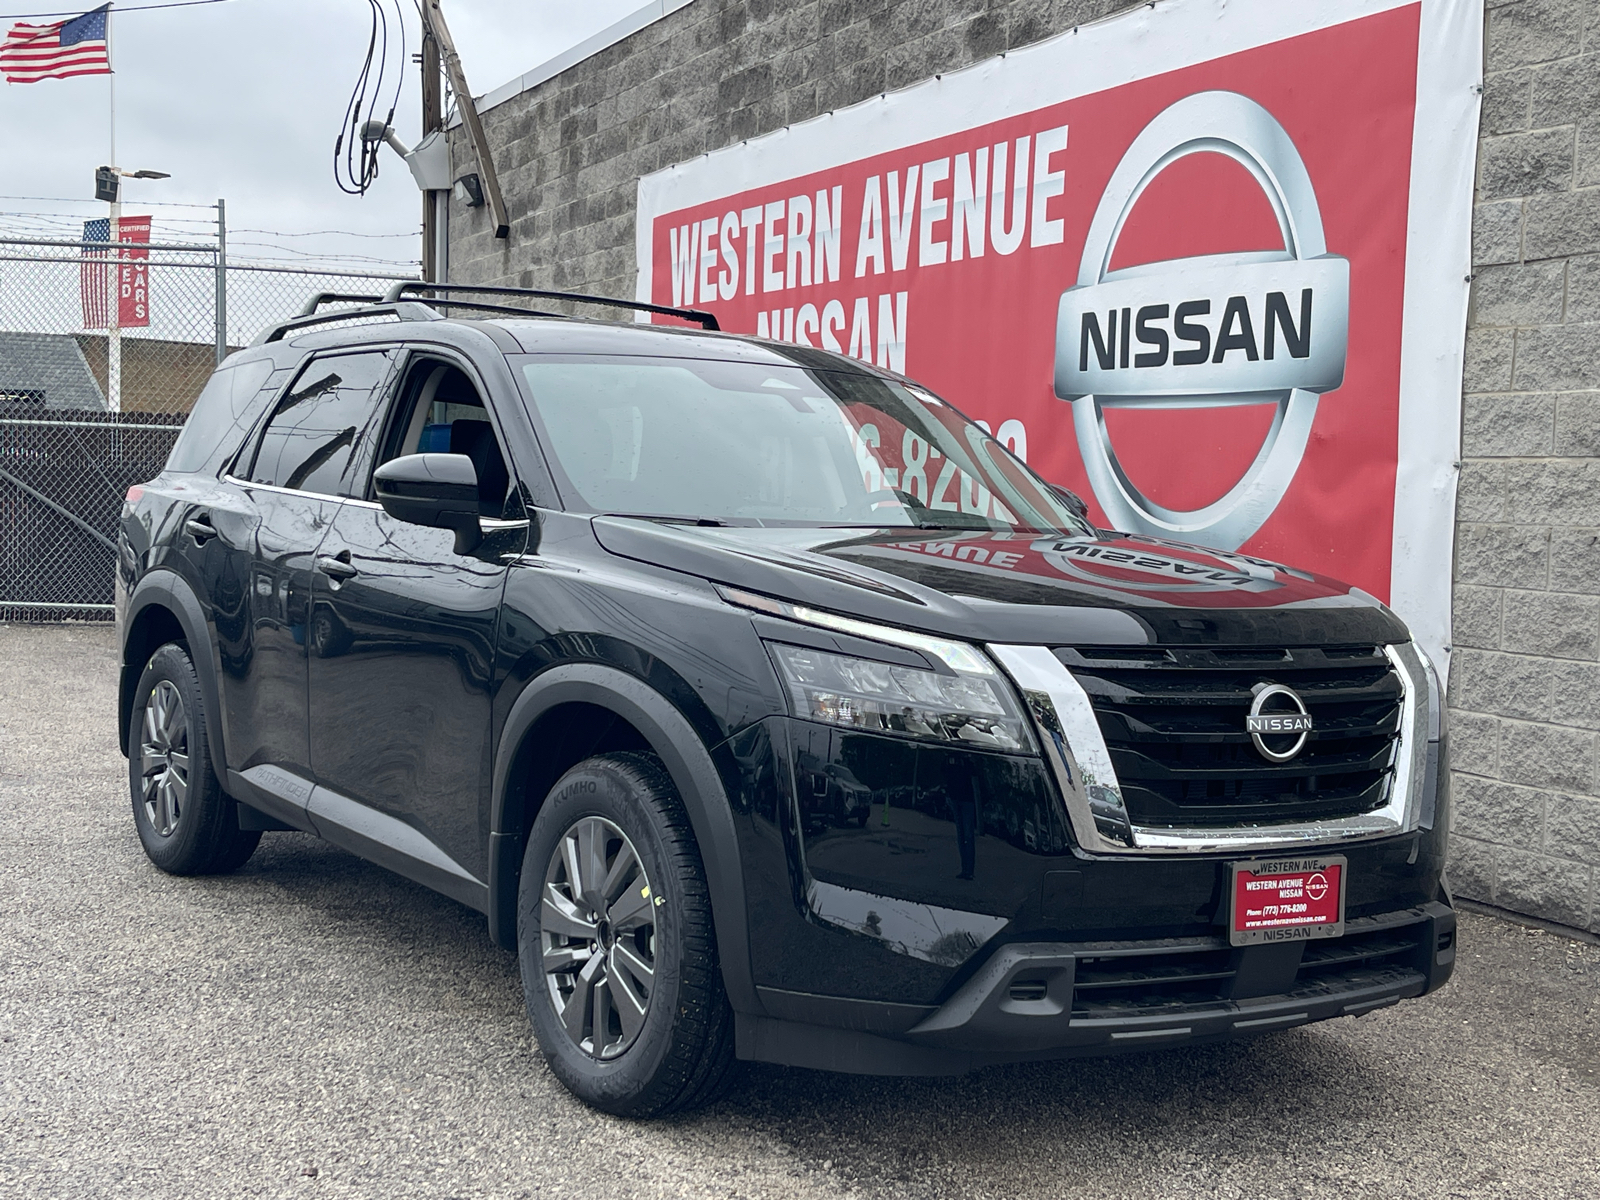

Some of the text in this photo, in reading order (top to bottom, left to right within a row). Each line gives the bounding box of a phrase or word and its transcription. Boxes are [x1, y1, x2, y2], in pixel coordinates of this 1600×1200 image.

[669, 124, 1069, 307] WESTERN AVENUE
[120, 224, 150, 233] CERTIFIED
[121, 237, 132, 298] USED
[134, 257, 146, 319] CARS
[1079, 288, 1313, 372] NISSAN
[1249, 717, 1312, 731] NISSAN
[553, 780, 597, 808] KUMHO
[1260, 861, 1300, 873] WESTERN
[1246, 879, 1303, 891] WESTERN AVENUE
[1279, 889, 1303, 899] NISSAN
[1262, 905, 1279, 917] (773)
[1280, 903, 1307, 914] 776-8200
[1263, 927, 1311, 941] NISSAN
